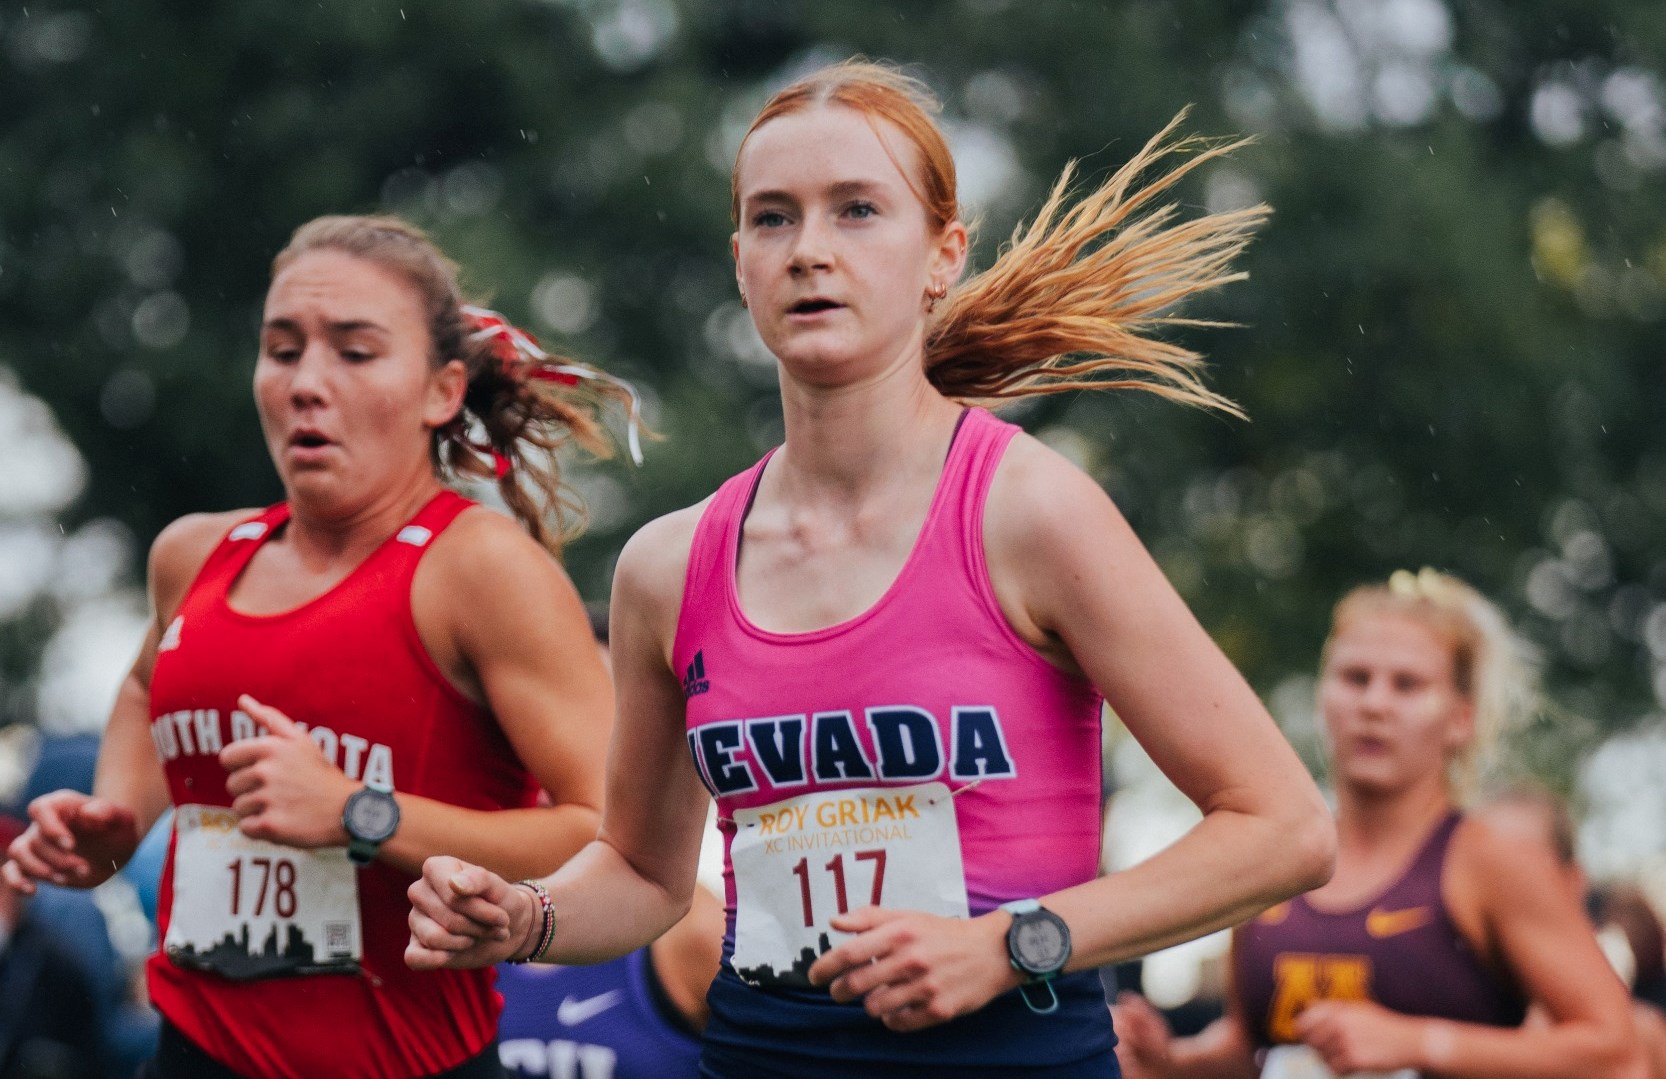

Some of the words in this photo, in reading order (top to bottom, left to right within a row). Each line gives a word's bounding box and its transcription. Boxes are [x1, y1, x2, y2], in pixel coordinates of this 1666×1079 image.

[151, 708, 223, 766] UTH
[230, 709, 394, 789] DOTA
[687, 705, 1016, 799] EVADA
[759, 804, 809, 837] ROY
[815, 794, 921, 828] GRIAK
[765, 838, 783, 855] XC
[787, 825, 913, 851] INVITATIONAL
[227, 858, 297, 919] 178
[792, 849, 887, 928] 117
